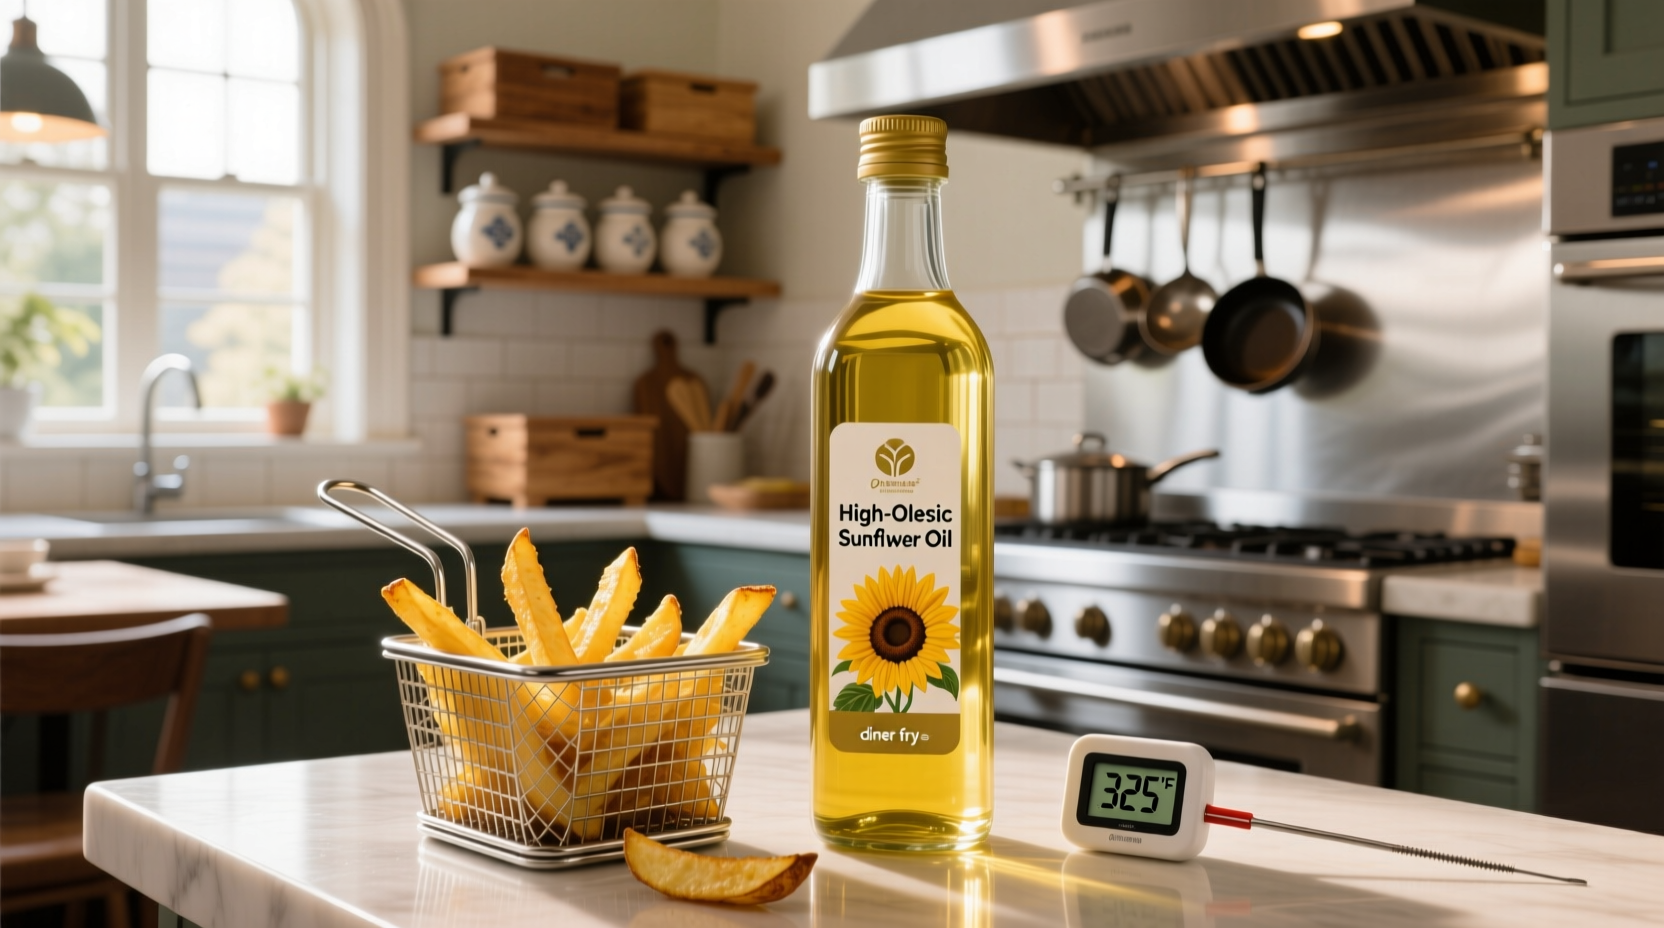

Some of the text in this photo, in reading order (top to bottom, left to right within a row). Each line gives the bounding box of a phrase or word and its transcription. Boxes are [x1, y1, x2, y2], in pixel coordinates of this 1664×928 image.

[839, 503, 952, 527] High-Olesic
[925, 529, 952, 548] Oil
[899, 727, 919, 746] fry
